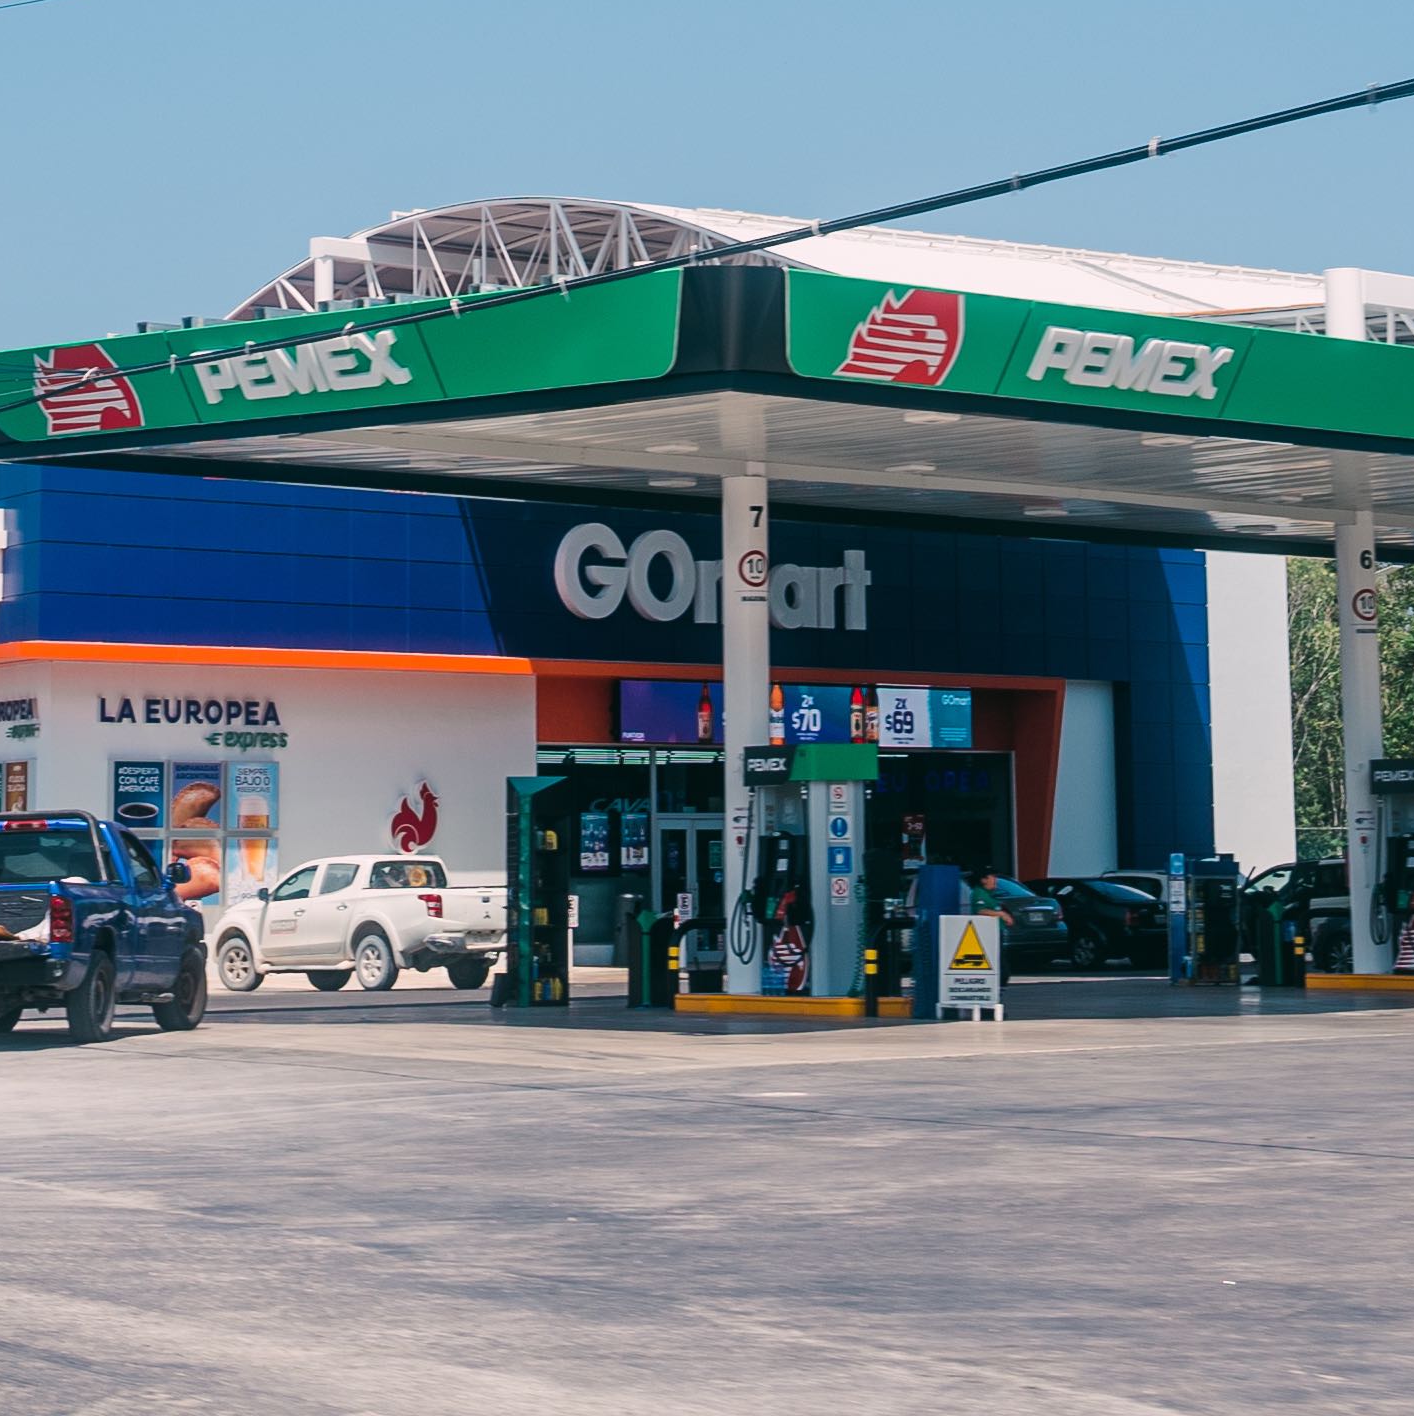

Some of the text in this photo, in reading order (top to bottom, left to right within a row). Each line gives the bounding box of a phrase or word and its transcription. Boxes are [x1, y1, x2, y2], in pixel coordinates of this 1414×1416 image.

[189, 329, 412, 404] PEMEX
[1026, 325, 1236, 400] PEMEX
[749, 505, 764, 528] 7
[747, 558, 764, 574] 10
[1360, 549, 1373, 570] 6
[100, 698, 281, 726] LA EUROPEA
[791, 708, 821, 732] $70
[885, 710, 915, 734] $69
[224, 732, 288, 752] express
[747, 757, 787, 772] PEMEX
[118, 775, 138, 785] CON
[235, 775, 262, 786] BAJO
